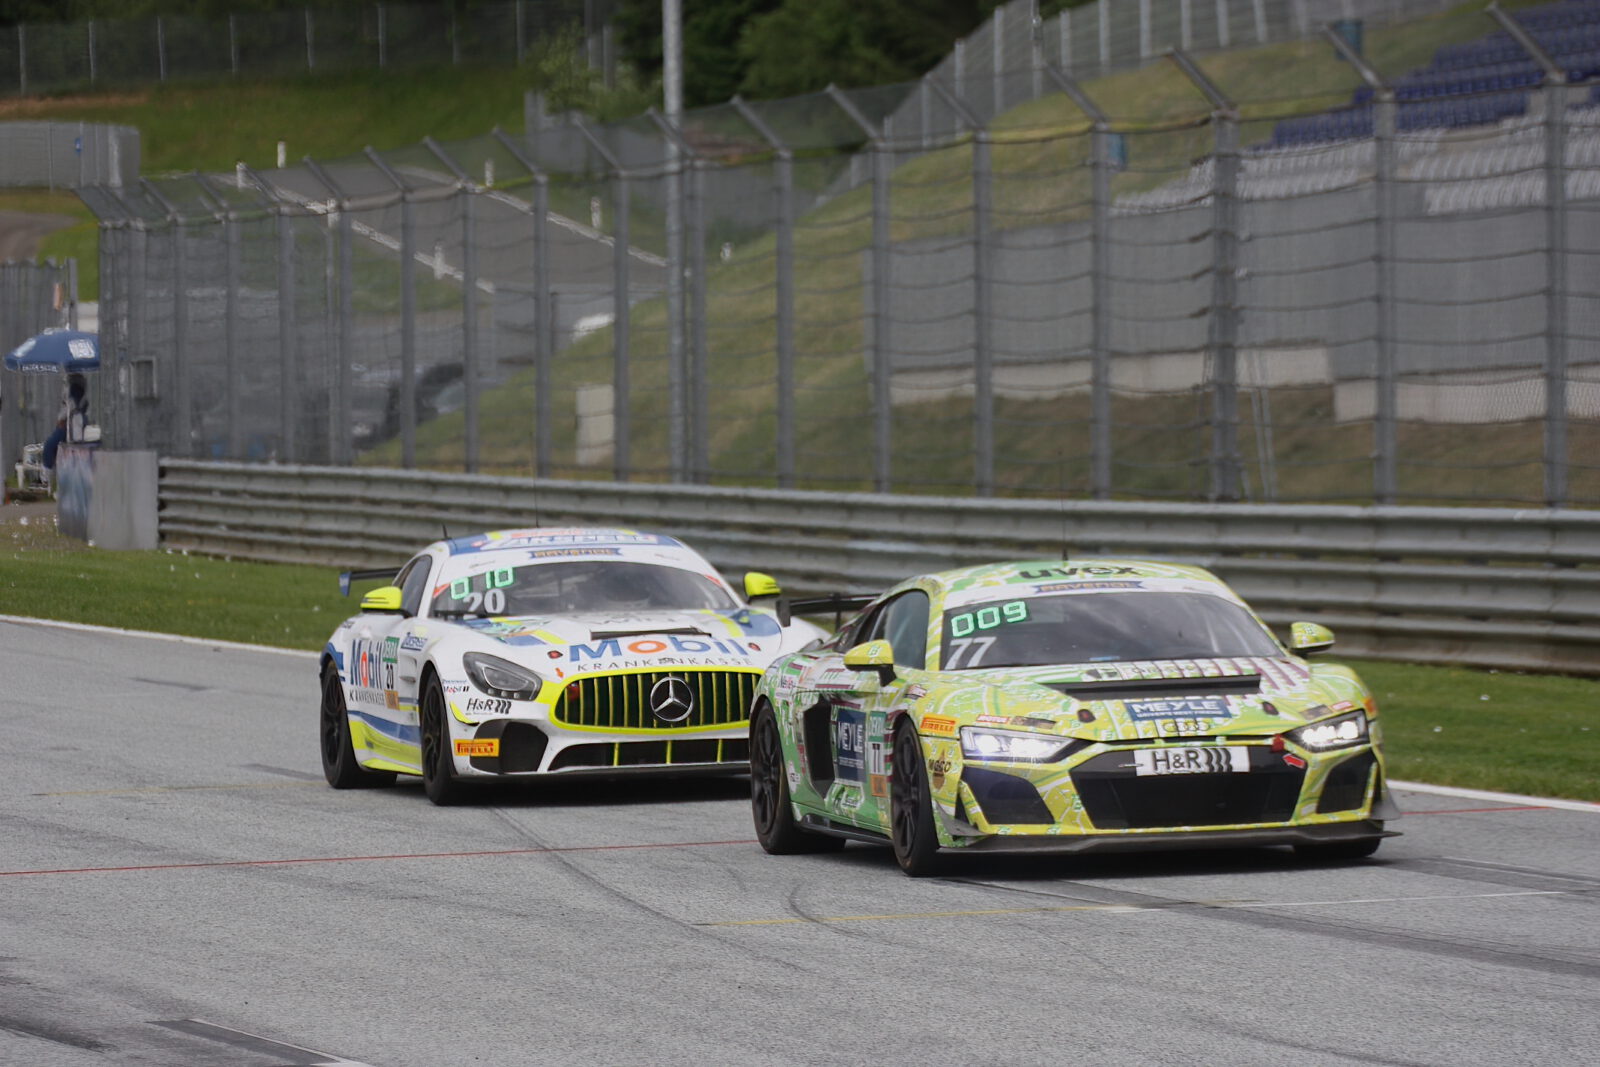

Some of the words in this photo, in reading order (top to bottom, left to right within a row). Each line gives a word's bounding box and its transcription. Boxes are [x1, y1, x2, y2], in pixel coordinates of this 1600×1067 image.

[1020, 567, 1141, 579] uvex
[463, 588, 505, 619] 20
[951, 601, 1027, 638] 009
[569, 636, 749, 662] Mobil
[944, 636, 997, 670] 77
[350, 639, 383, 690] Mobil
[466, 697, 494, 711] H&R
[1131, 701, 1220, 713] MEYLE
[456, 743, 494, 753] PIRELLI
[1152, 749, 1202, 770] H&R
